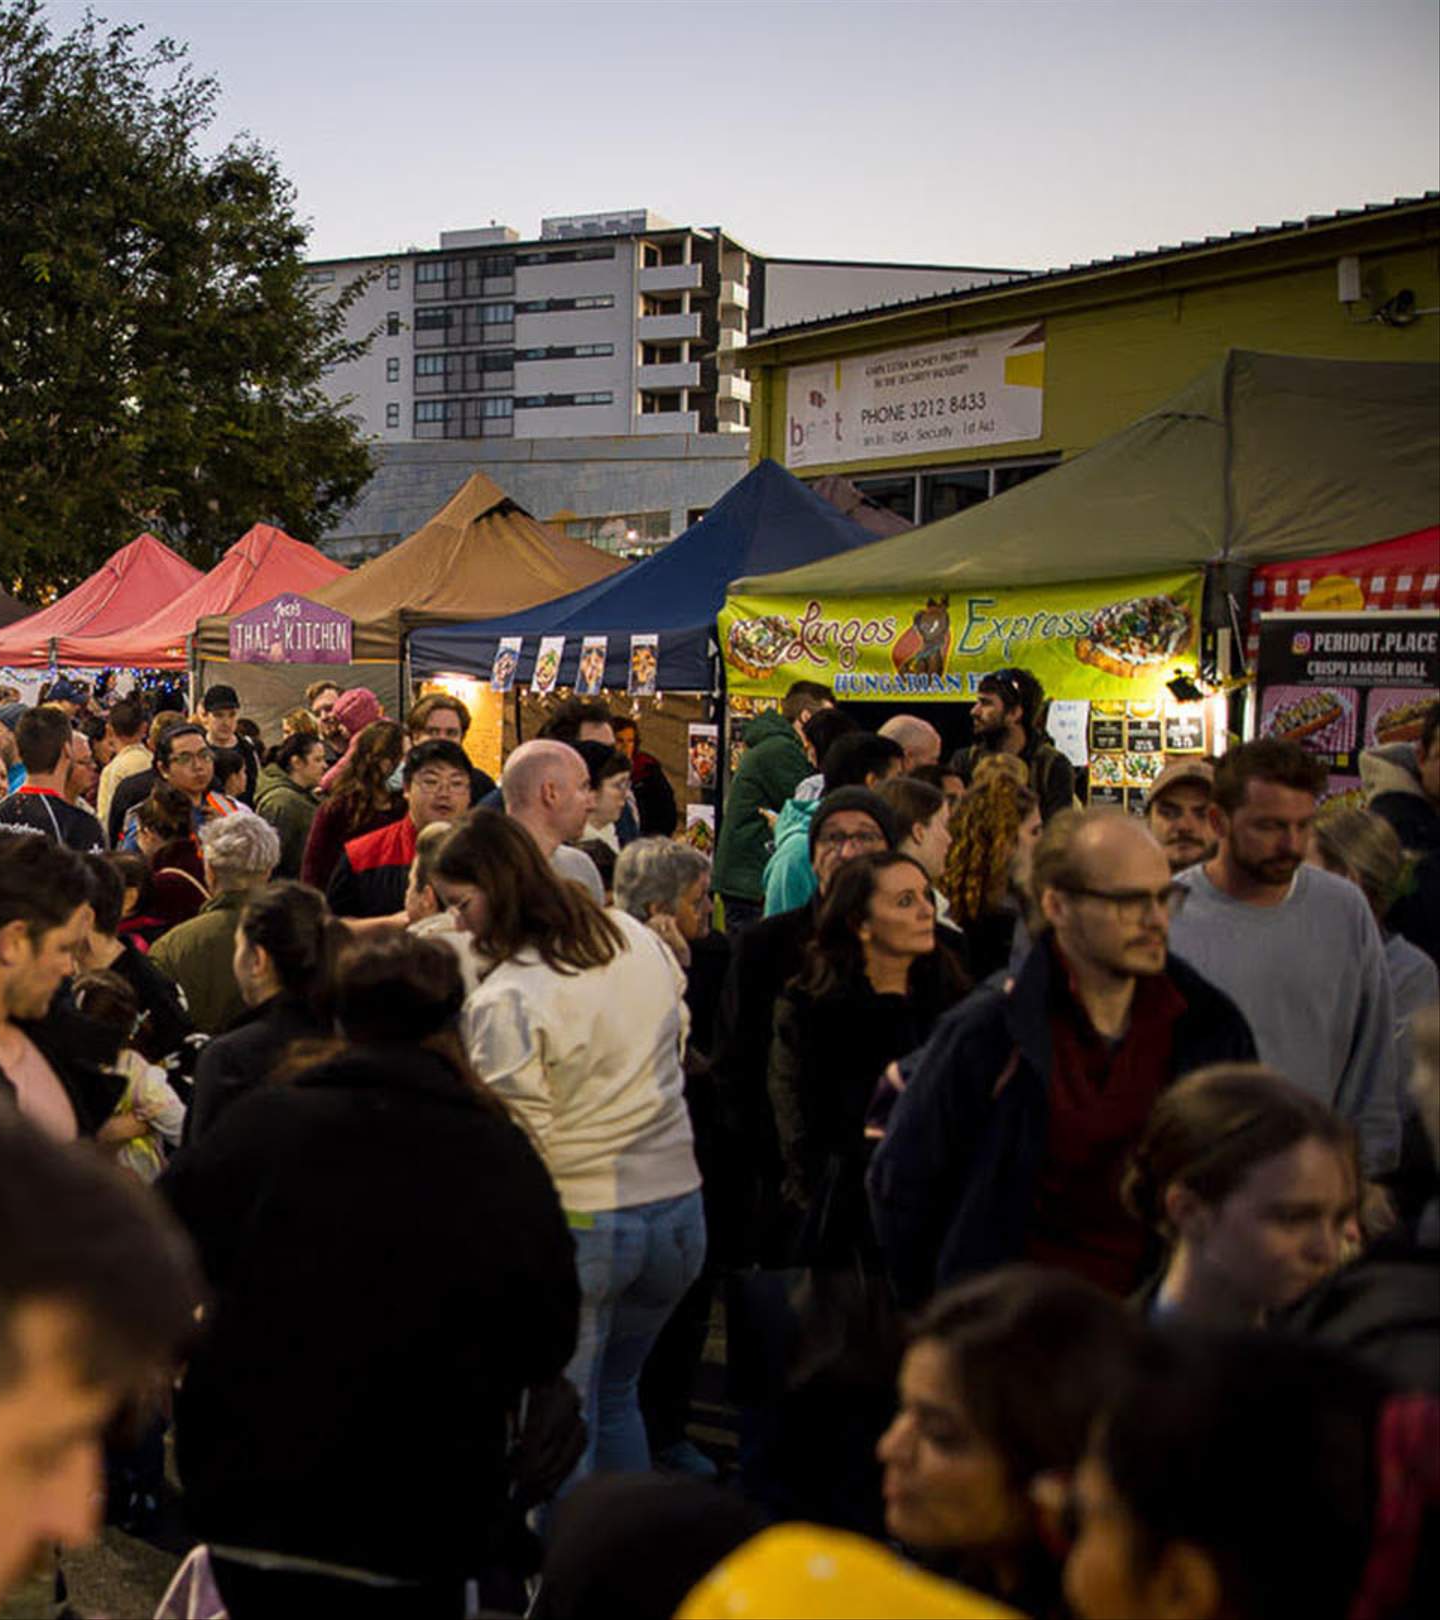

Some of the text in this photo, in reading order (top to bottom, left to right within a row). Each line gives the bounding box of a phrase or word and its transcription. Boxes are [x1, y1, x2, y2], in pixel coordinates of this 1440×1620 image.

[861, 392, 986, 424] PHONE 3212 8433
[235, 622, 347, 652] THAI KITCHEN
[786, 598, 1093, 671] Langos Express
[1312, 631, 1439, 653] PERIDOT.PLACE
[834, 672, 962, 694] HUNGARIAN
